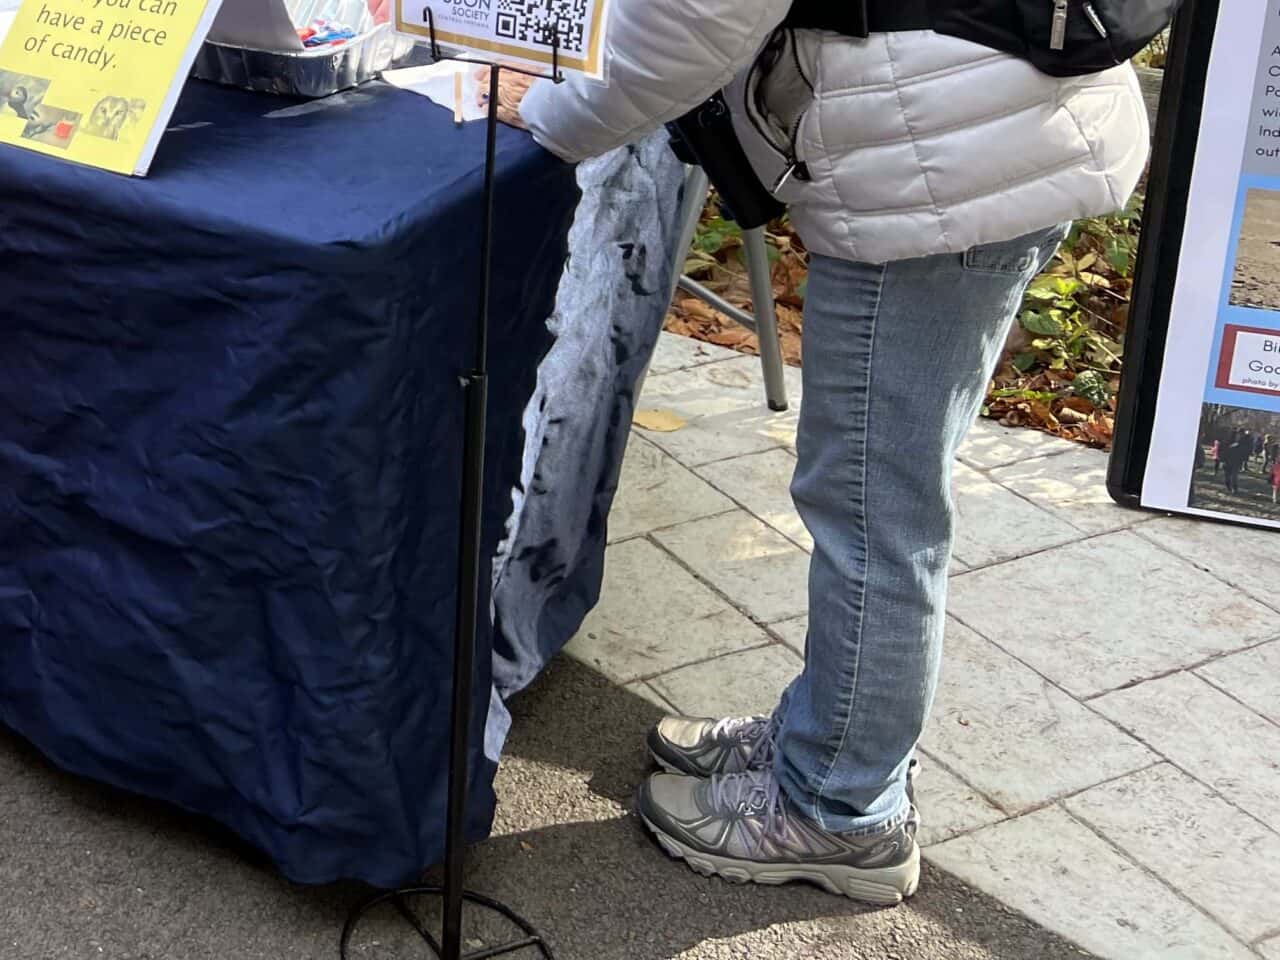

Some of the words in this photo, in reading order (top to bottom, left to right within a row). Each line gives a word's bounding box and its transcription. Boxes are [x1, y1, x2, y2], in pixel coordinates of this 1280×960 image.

[37, 4, 85, 31] have
[90, 19, 104, 35] a
[107, 20, 167, 46] piece
[452, 6, 489, 20] SOCIETY
[24, 34, 51, 53] of
[51, 40, 117, 72] candy.
